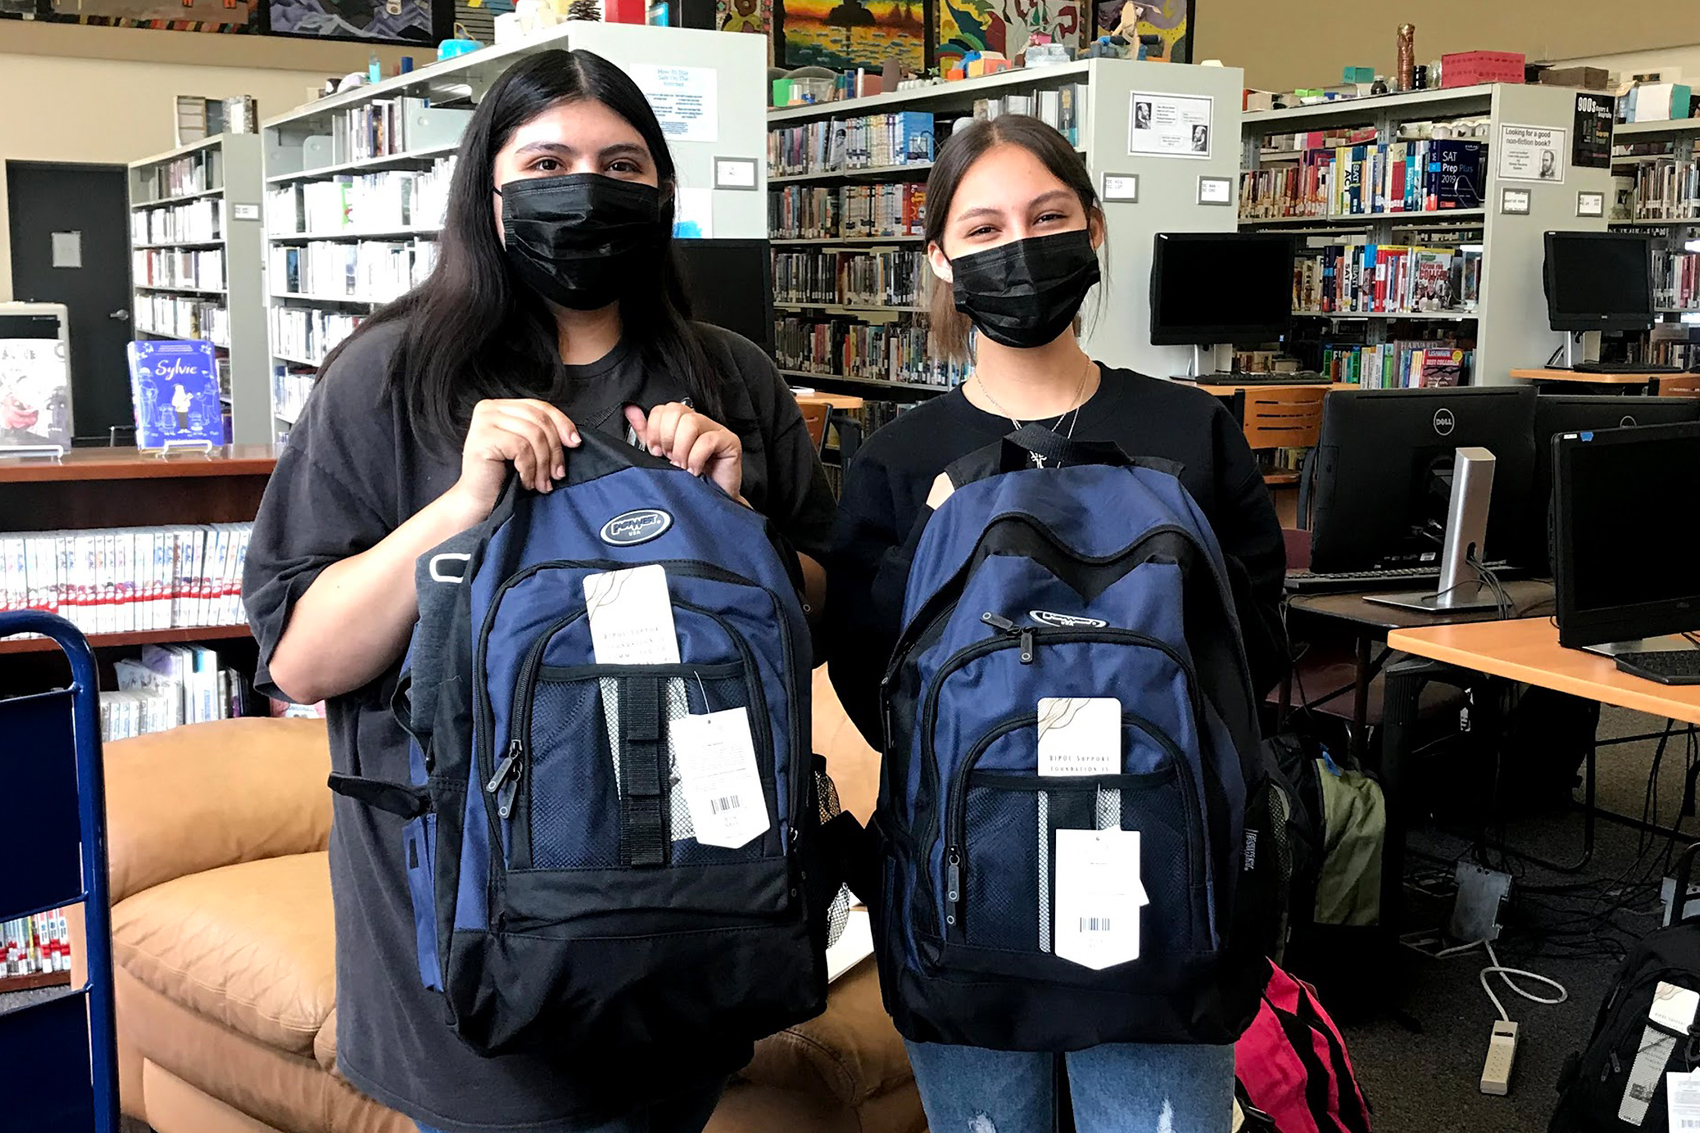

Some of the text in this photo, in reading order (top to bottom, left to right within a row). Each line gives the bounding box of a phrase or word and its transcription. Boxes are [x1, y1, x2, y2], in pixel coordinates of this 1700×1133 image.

[1578, 97, 1596, 113] 900s
[1505, 128, 1525, 137] Looking
[1538, 131, 1551, 139] good
[1506, 137, 1551, 147] non-fiction book?
[1442, 151, 1457, 162] SAT
[1352, 164, 1360, 183] SAT
[1442, 163, 1473, 174] Prep Plus
[1344, 170, 1352, 194] ACT
[1441, 175, 1457, 184] 2019
[155, 357, 198, 381] Sylvie
[1436, 418, 1452, 426] DELL
